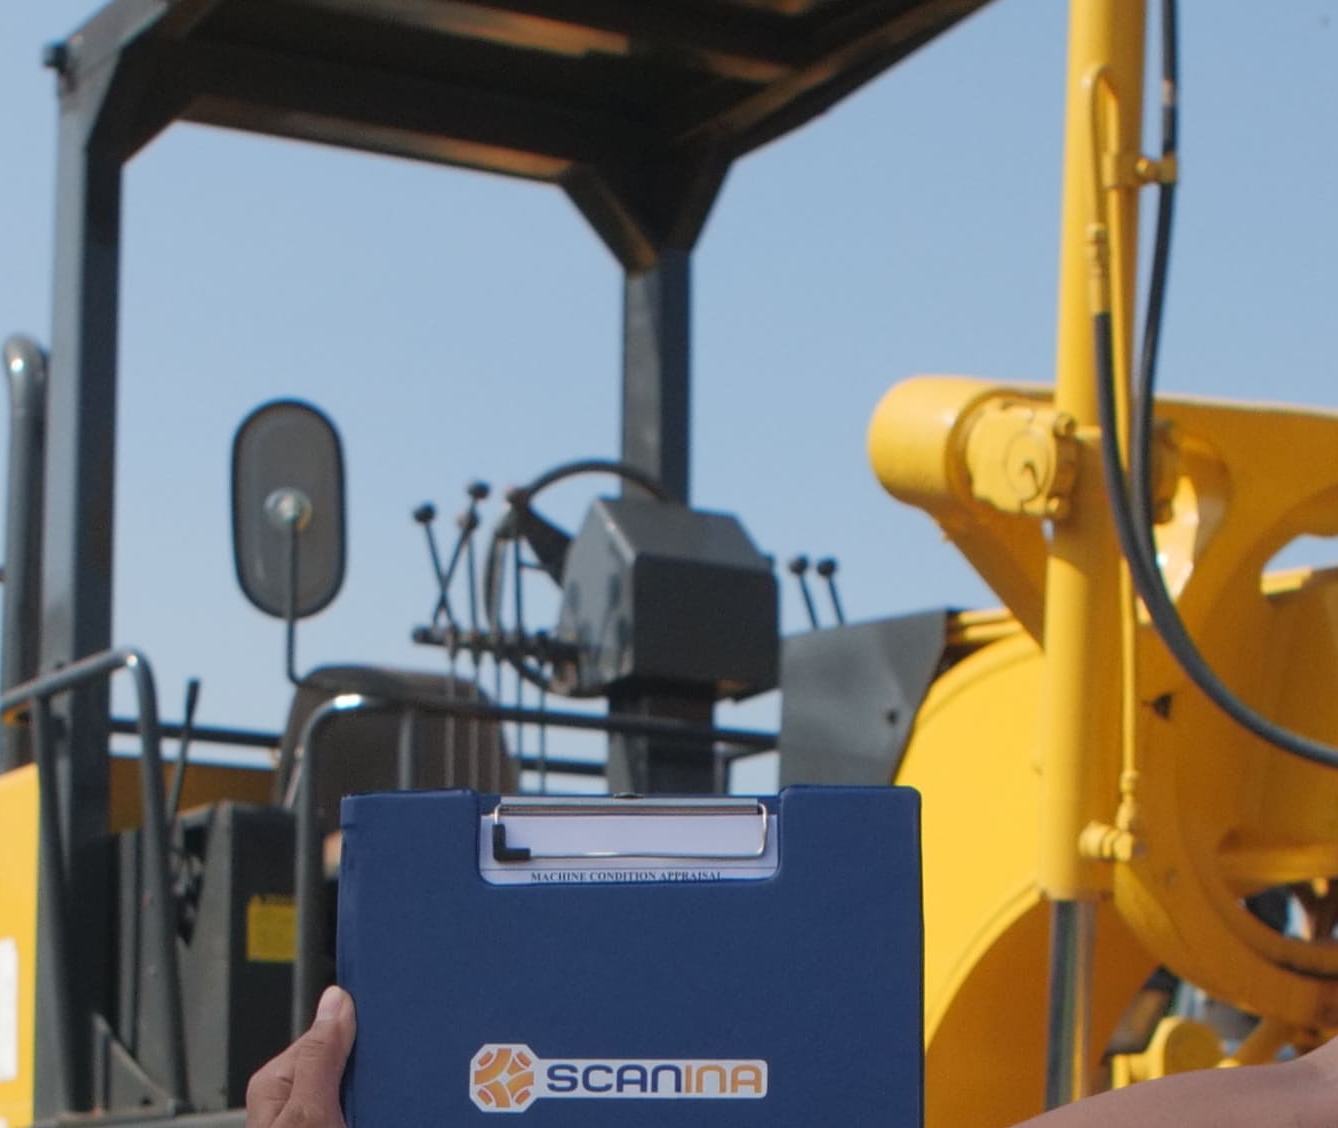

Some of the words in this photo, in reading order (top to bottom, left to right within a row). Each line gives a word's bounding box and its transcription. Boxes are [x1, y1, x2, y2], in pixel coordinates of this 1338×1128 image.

[531, 871, 586, 881] MACHINE
[589, 871, 657, 881] CONDITION
[546, 1063, 762, 1095] SCANINA
